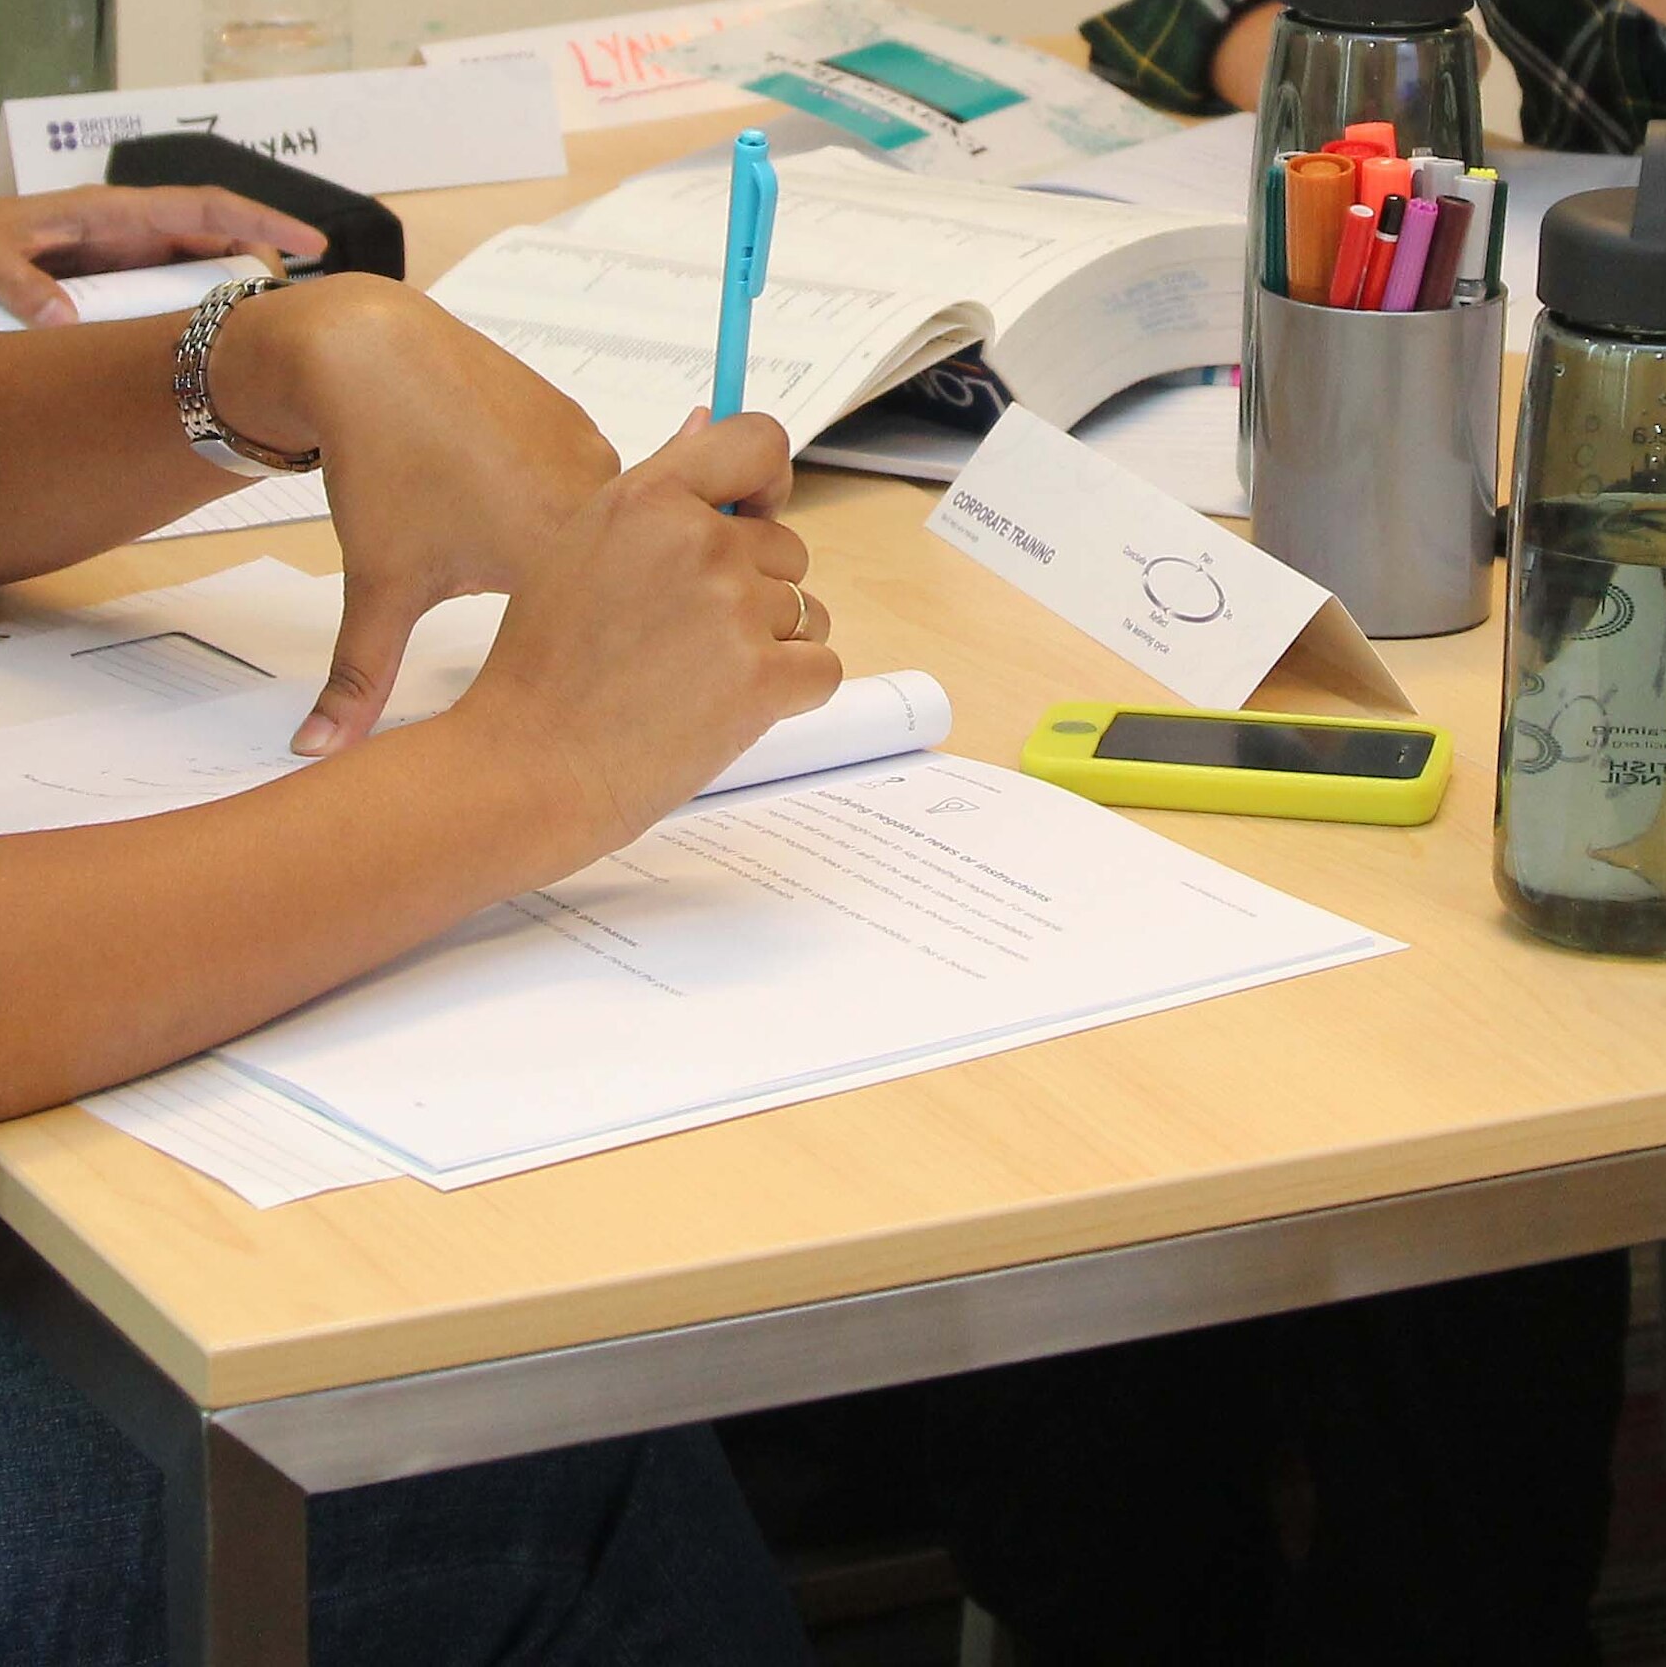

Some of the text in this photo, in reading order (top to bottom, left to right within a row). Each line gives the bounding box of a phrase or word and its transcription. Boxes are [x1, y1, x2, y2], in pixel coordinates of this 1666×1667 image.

[79, 115, 141, 134] BRITISH
[952, 491, 1012, 537] CORPORATE
[1007, 525, 1056, 565] TRAINING
[1123, 618, 1170, 655] The learning cycle
[810, 790, 1052, 902] Justifying negative news or instructions
